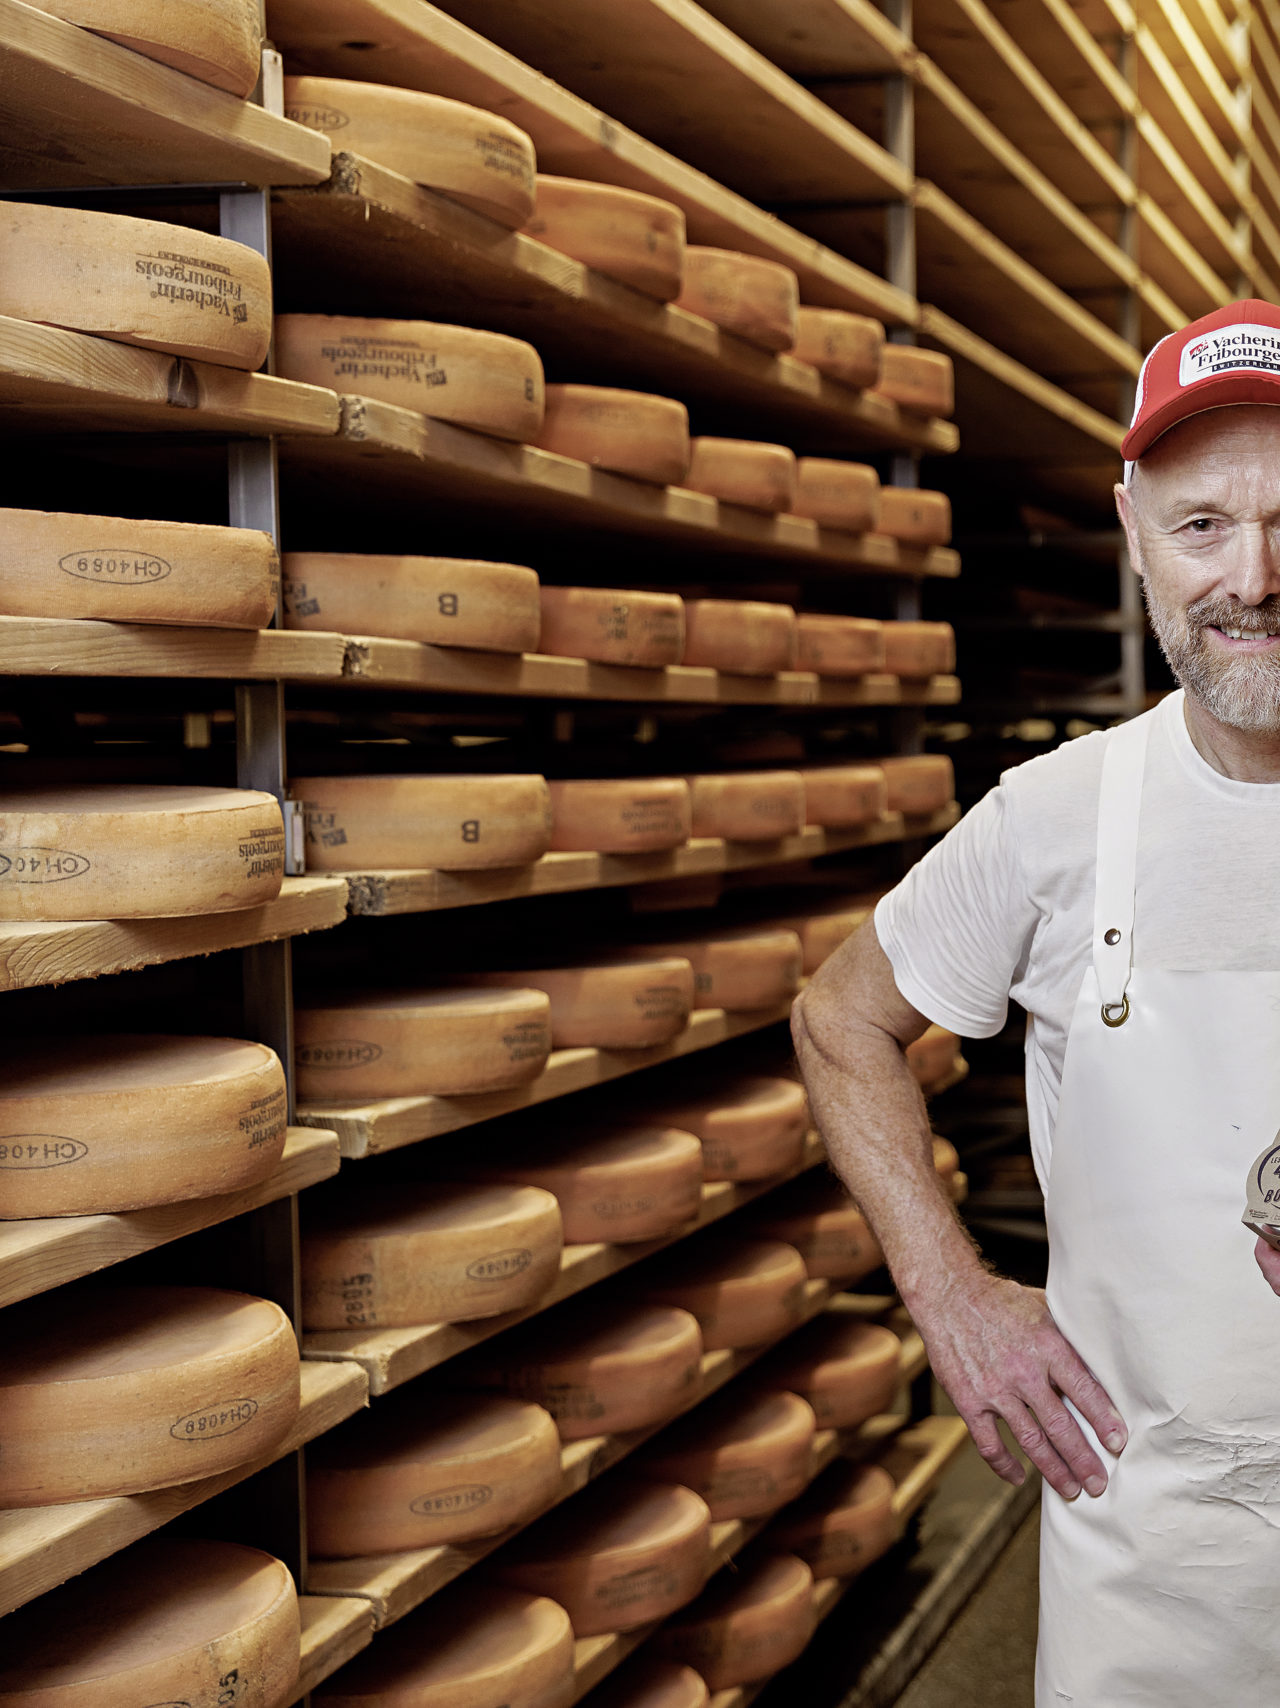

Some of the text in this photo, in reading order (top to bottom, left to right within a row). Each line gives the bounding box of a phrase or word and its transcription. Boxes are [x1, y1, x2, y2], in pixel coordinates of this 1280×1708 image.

[286, 108, 341, 125] CH40
[134, 260, 242, 301] Fribourgeois
[77, 556, 163, 577] CH4089
[439, 593, 459, 616] B
[462, 821, 480, 842] B
[185, 1403, 252, 1434] CH4089
